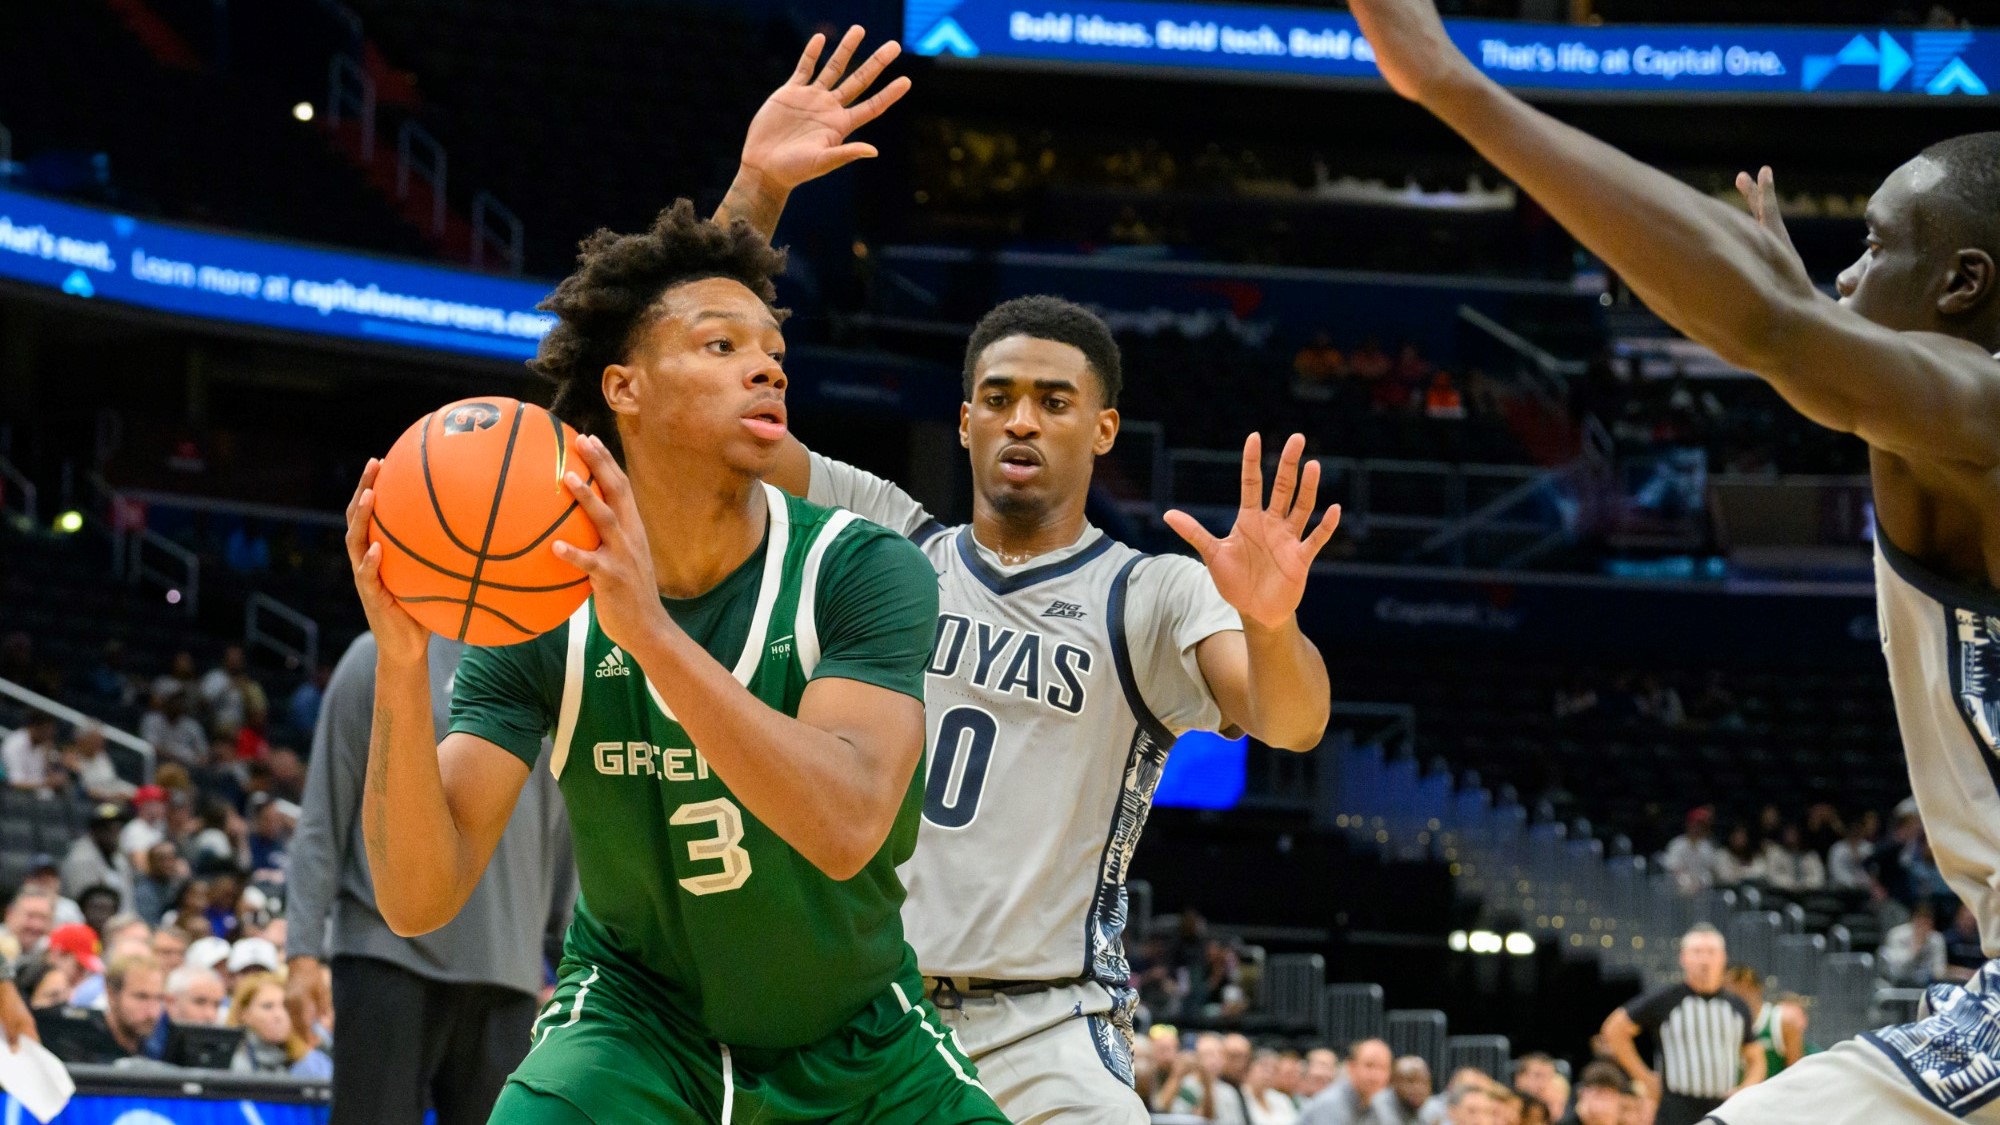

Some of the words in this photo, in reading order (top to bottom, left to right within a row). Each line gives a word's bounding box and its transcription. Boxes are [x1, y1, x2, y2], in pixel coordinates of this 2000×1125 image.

[1010, 11, 1073, 43] Bold
[1075, 14, 1153, 48] ideas.
[1156, 20, 1218, 52] Bold
[1220, 25, 1287, 56] tech.
[1288, 28, 1350, 60] Bold
[1479, 39, 1556, 72] That's
[1557, 41, 1600, 74] life
[1601, 47, 1630, 75] at
[1632, 44, 1723, 81] Capital
[0, 215, 56, 260] hat's
[58, 236, 116, 273] next.
[131, 248, 196, 288] Learn
[198, 266, 262, 299] more
[262, 275, 291, 304] at
[1044, 607, 1088, 619] EAST
[1051, 600, 1082, 611] BIG
[595, 665, 630, 678] adids
[771, 643, 791, 655] HOR
[926, 611, 1094, 717] OYAS
[593, 741, 709, 782] GRE
[922, 704, 1000, 831] 0
[669, 797, 752, 896] 3
